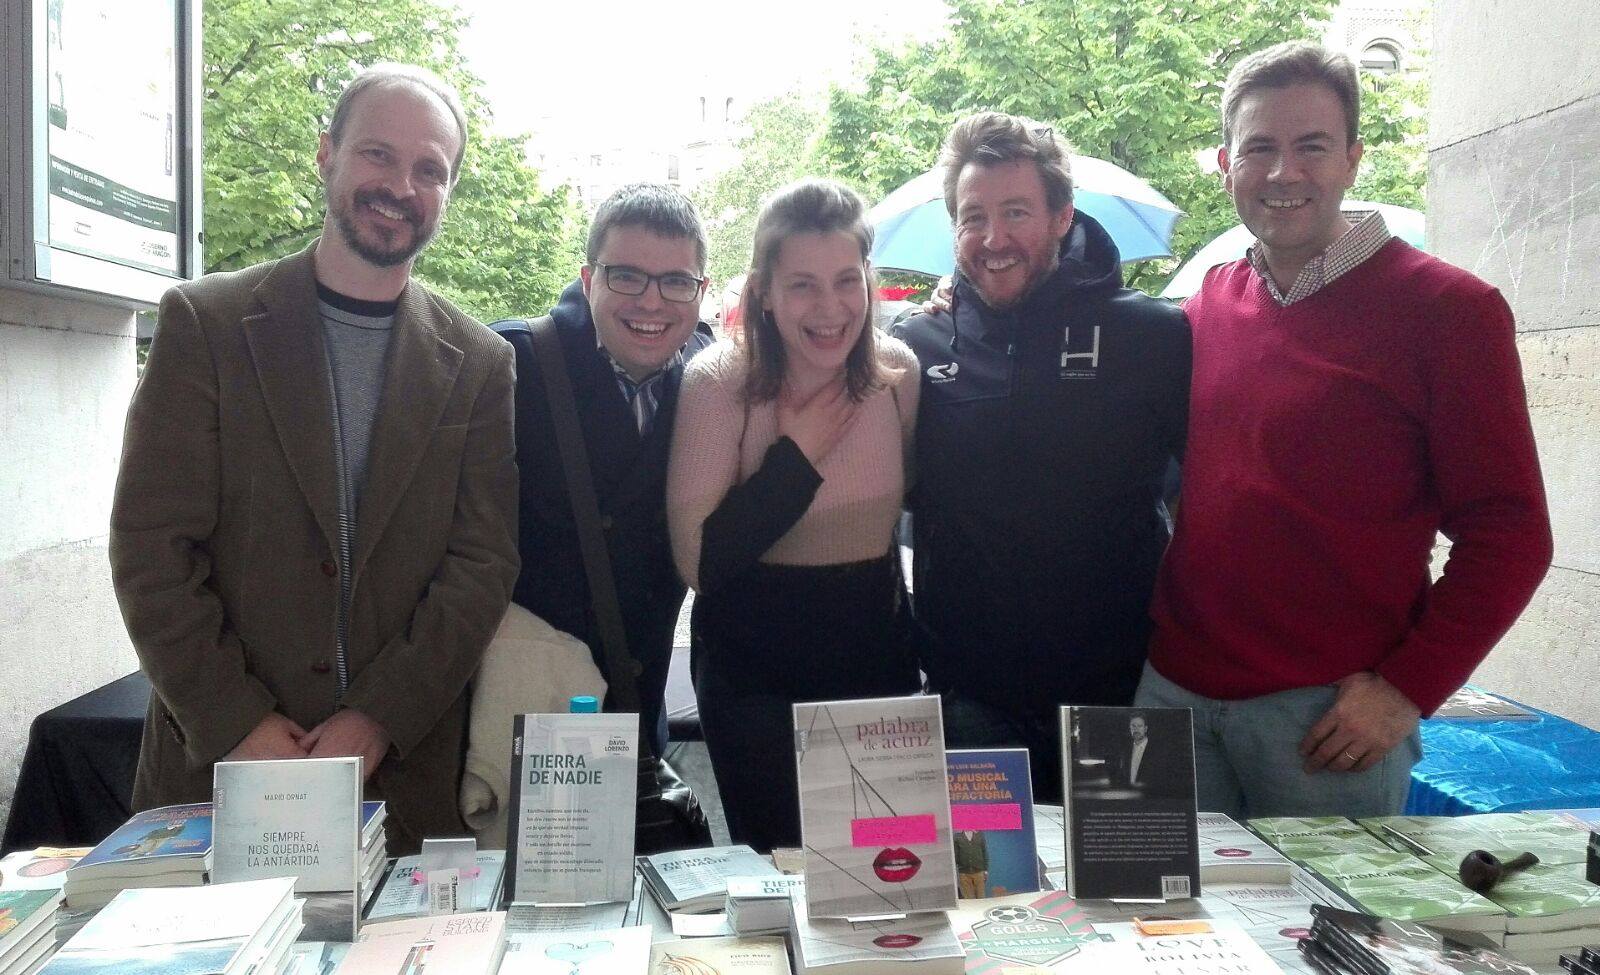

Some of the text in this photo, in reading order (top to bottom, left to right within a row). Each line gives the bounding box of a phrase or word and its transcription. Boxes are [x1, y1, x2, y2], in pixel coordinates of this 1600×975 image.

[856, 716, 930, 742] palabra
[864, 735, 932, 751] de actriz
[530, 754, 587, 769] TIERRA
[529, 770, 603, 785] DE NADIE
[957, 772, 1009, 782] MUSICAL
[973, 782, 998, 791] UNA
[263, 831, 306, 843] SIEMPRE
[248, 840, 320, 855] NOS QUEDARÁ
[247, 854, 320, 868] LA ANTÁRTIDA
[989, 923, 1050, 936] GOLES
[993, 936, 1063, 948] MARGEN
